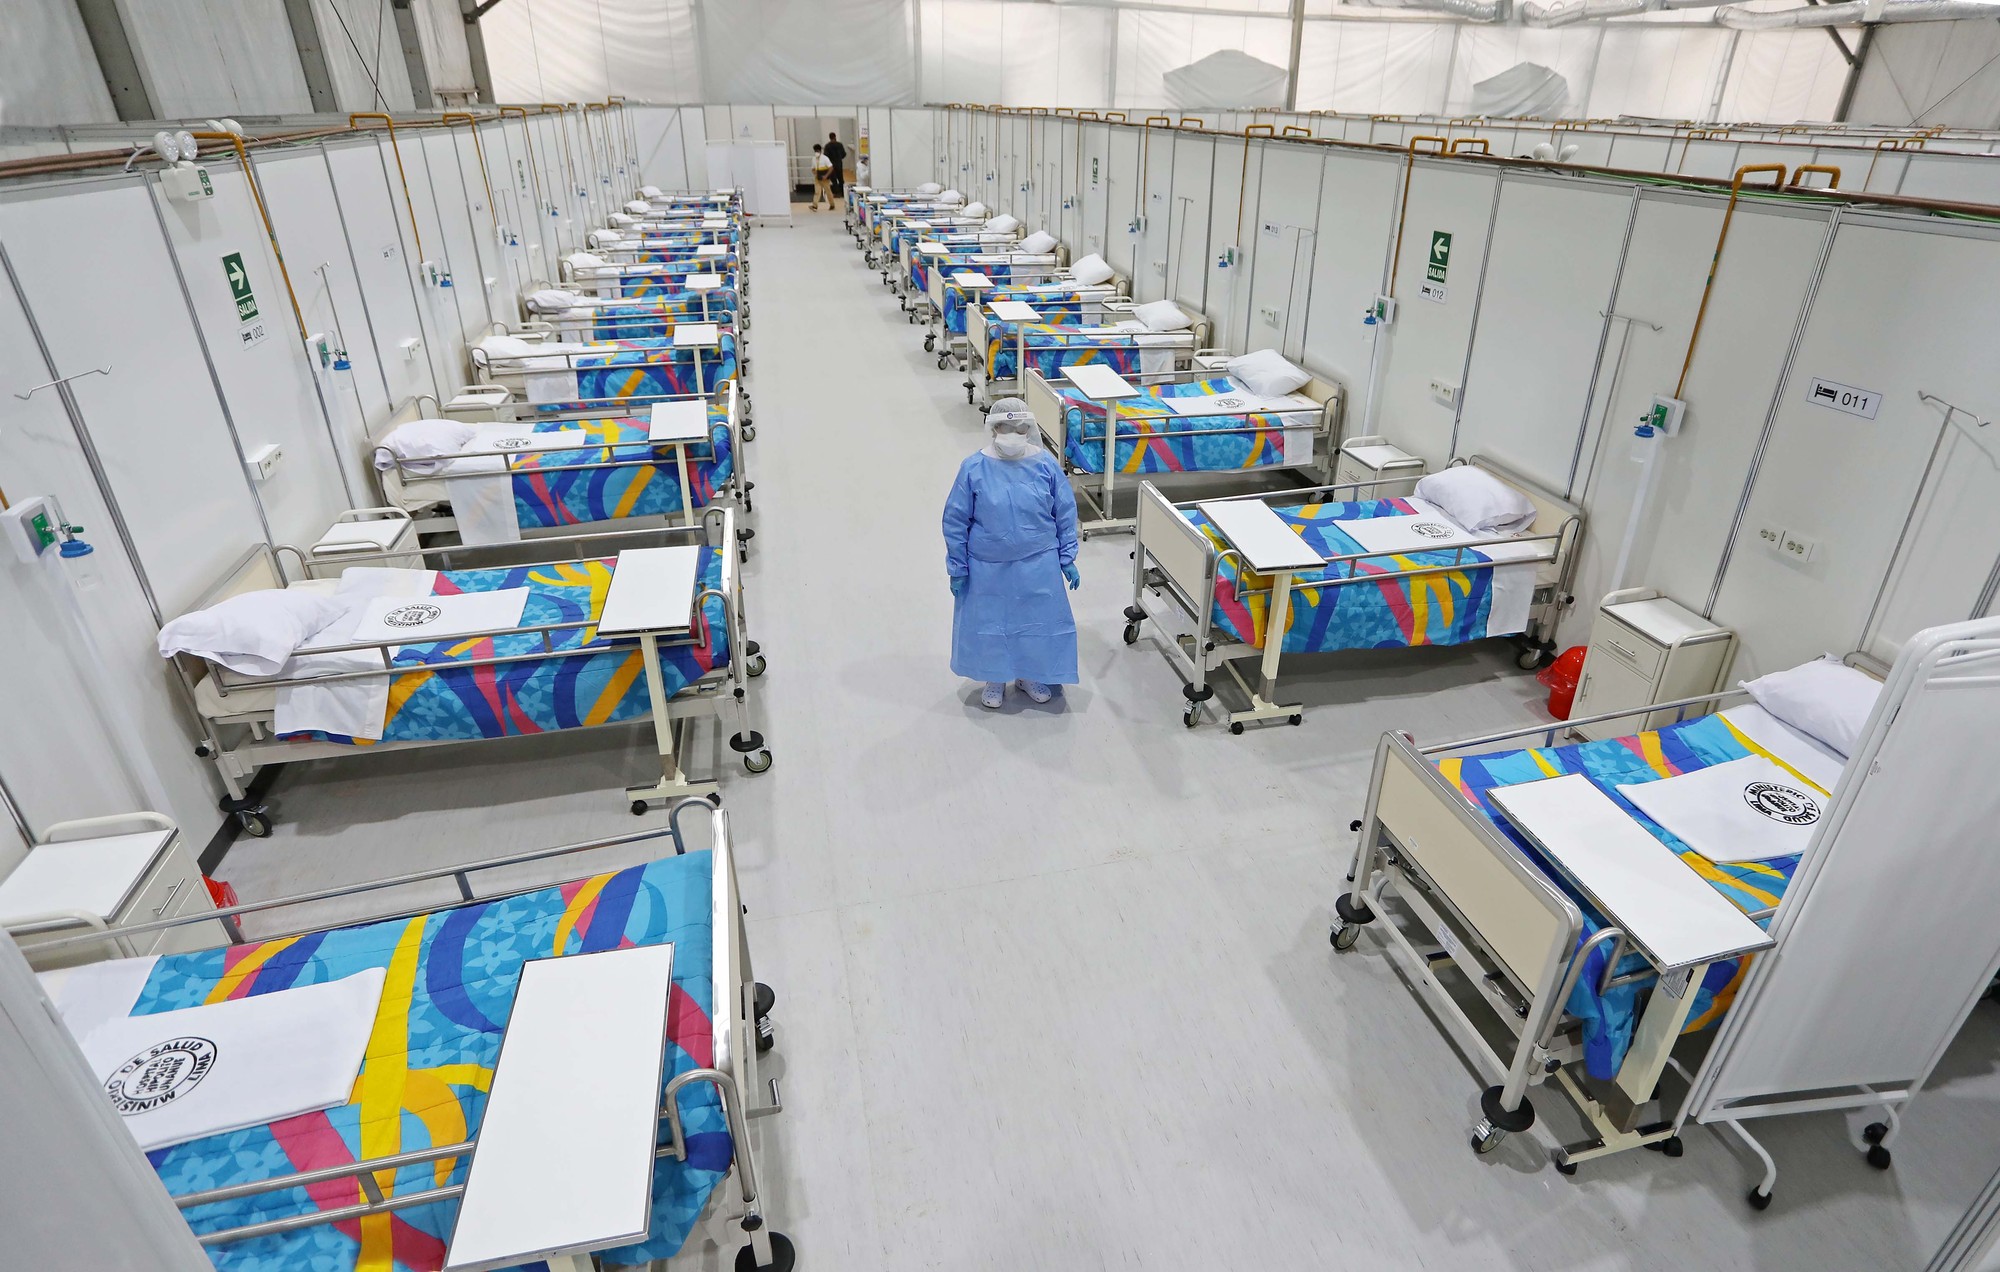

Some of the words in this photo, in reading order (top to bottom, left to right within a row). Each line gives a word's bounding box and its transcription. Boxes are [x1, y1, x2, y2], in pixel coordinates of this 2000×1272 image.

[1428, 267, 1445, 279] SALIDA
[1432, 289, 1444, 299] 012
[238, 300, 257, 316] SALIDA
[253, 325, 264, 339] 002
[1841, 392, 1868, 410] 011
[1783, 812, 1816, 823] SALUD
[120, 1057, 144, 1074] DE
[150, 1040, 203, 1056] SALUD
[187, 1051, 212, 1081] LIMA
[132, 1058, 162, 1095] HOSPITAL
[145, 1056, 174, 1093] HIPOLITO
[159, 1057, 186, 1091] UNANUE
